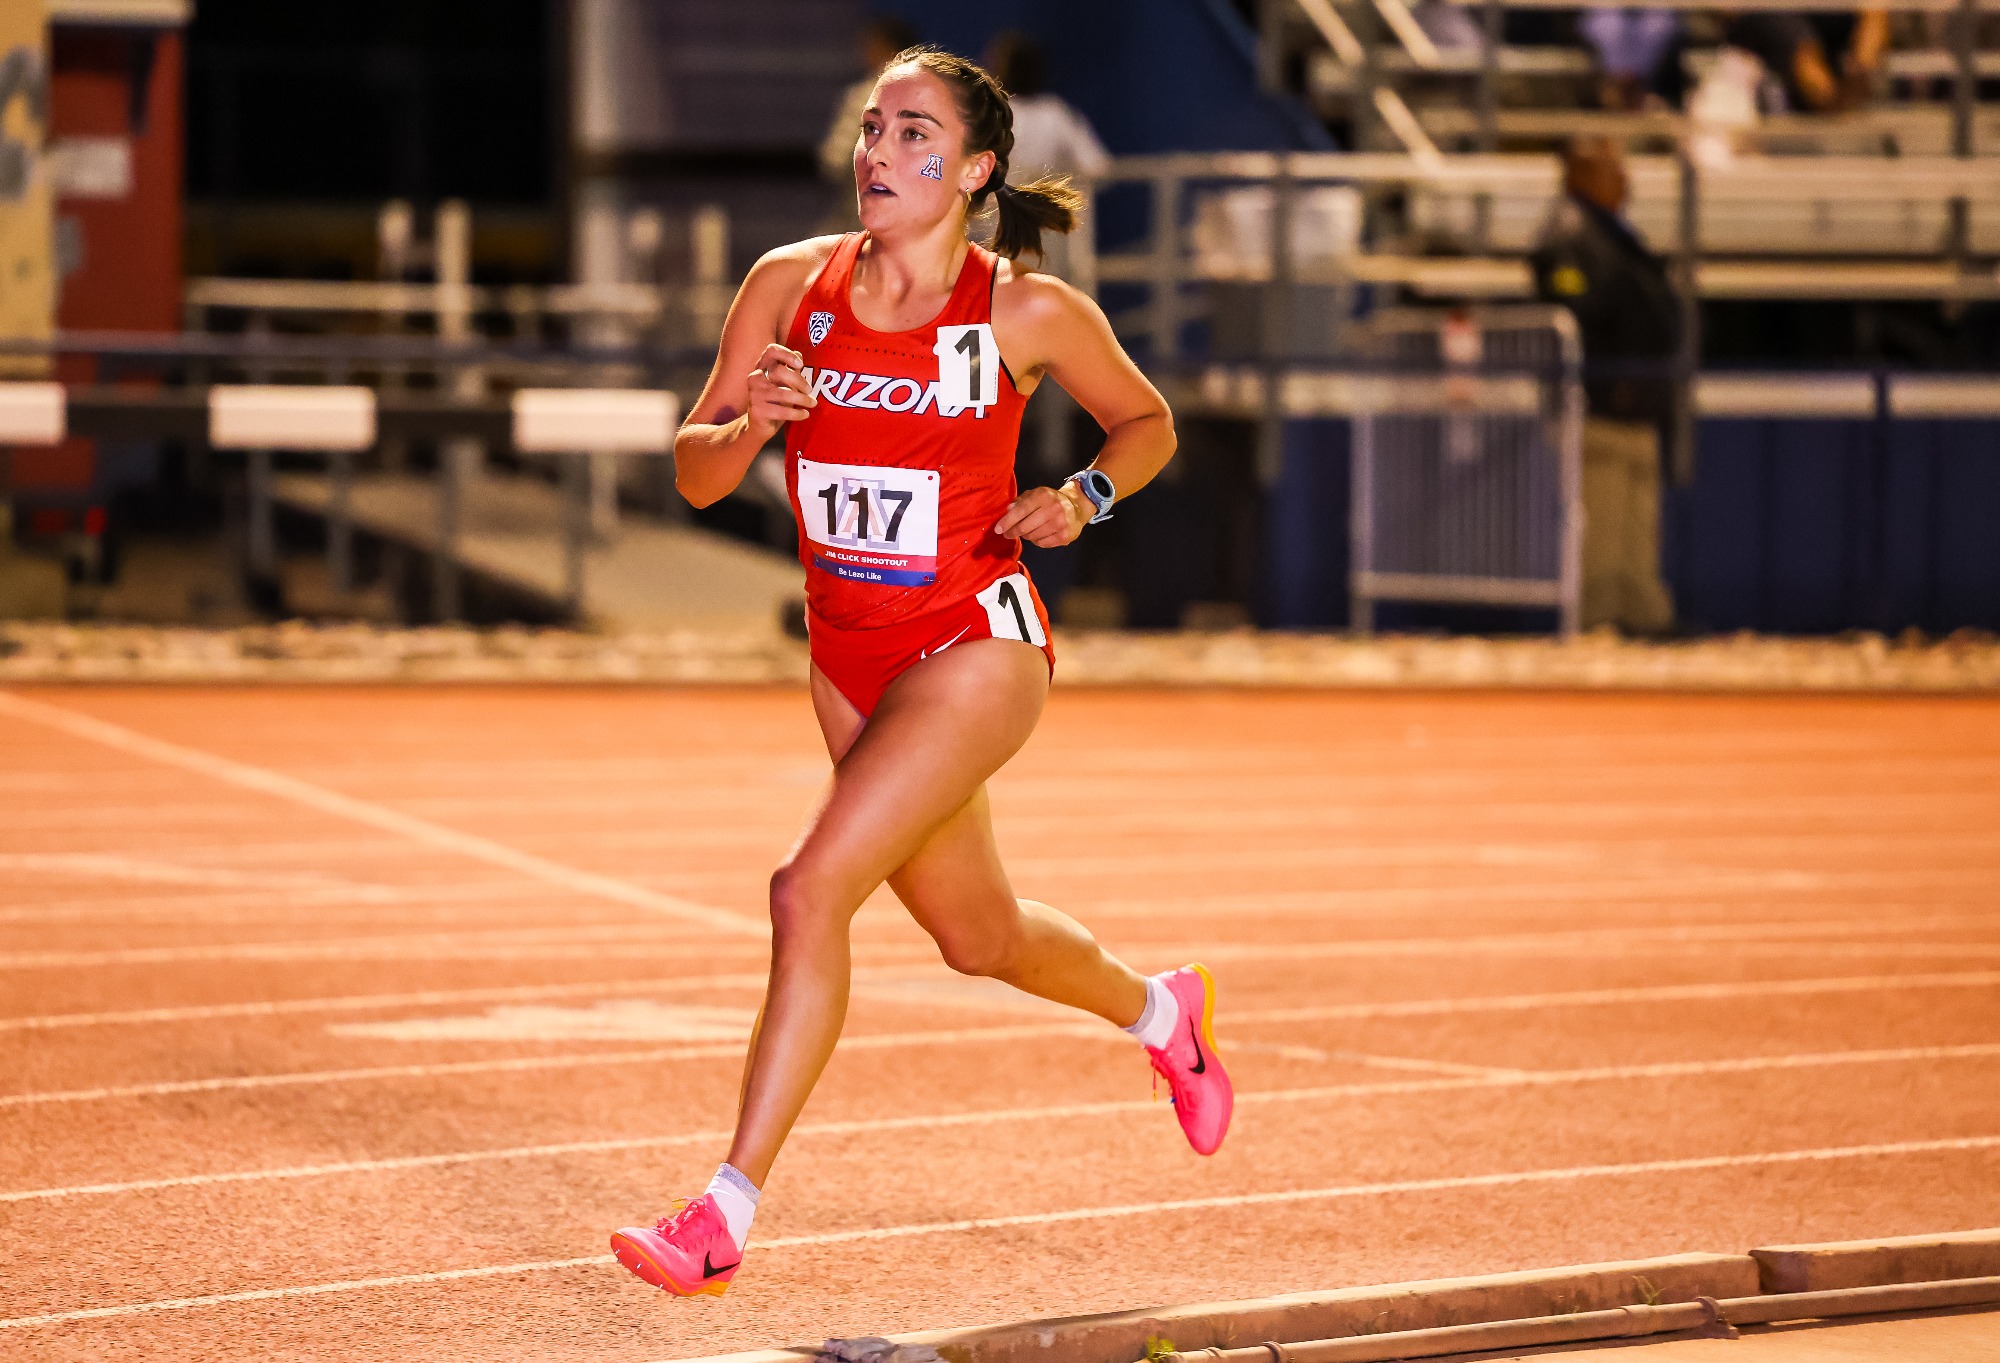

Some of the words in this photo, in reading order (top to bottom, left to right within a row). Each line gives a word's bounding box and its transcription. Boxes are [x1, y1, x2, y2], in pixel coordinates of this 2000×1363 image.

[920, 154, 943, 180] A
[812, 329, 823, 340] 12
[955, 329, 980, 401] 1
[800, 365, 986, 419] RIZON
[818, 483, 913, 542] 117
[825, 550, 836, 558] JIM
[837, 553, 859, 562] CLICK
[861, 556, 908, 566] SHOOTOUT
[838, 567, 847, 576] Be
[866, 572, 882, 580] Like
[998, 581, 1031, 644] 1
